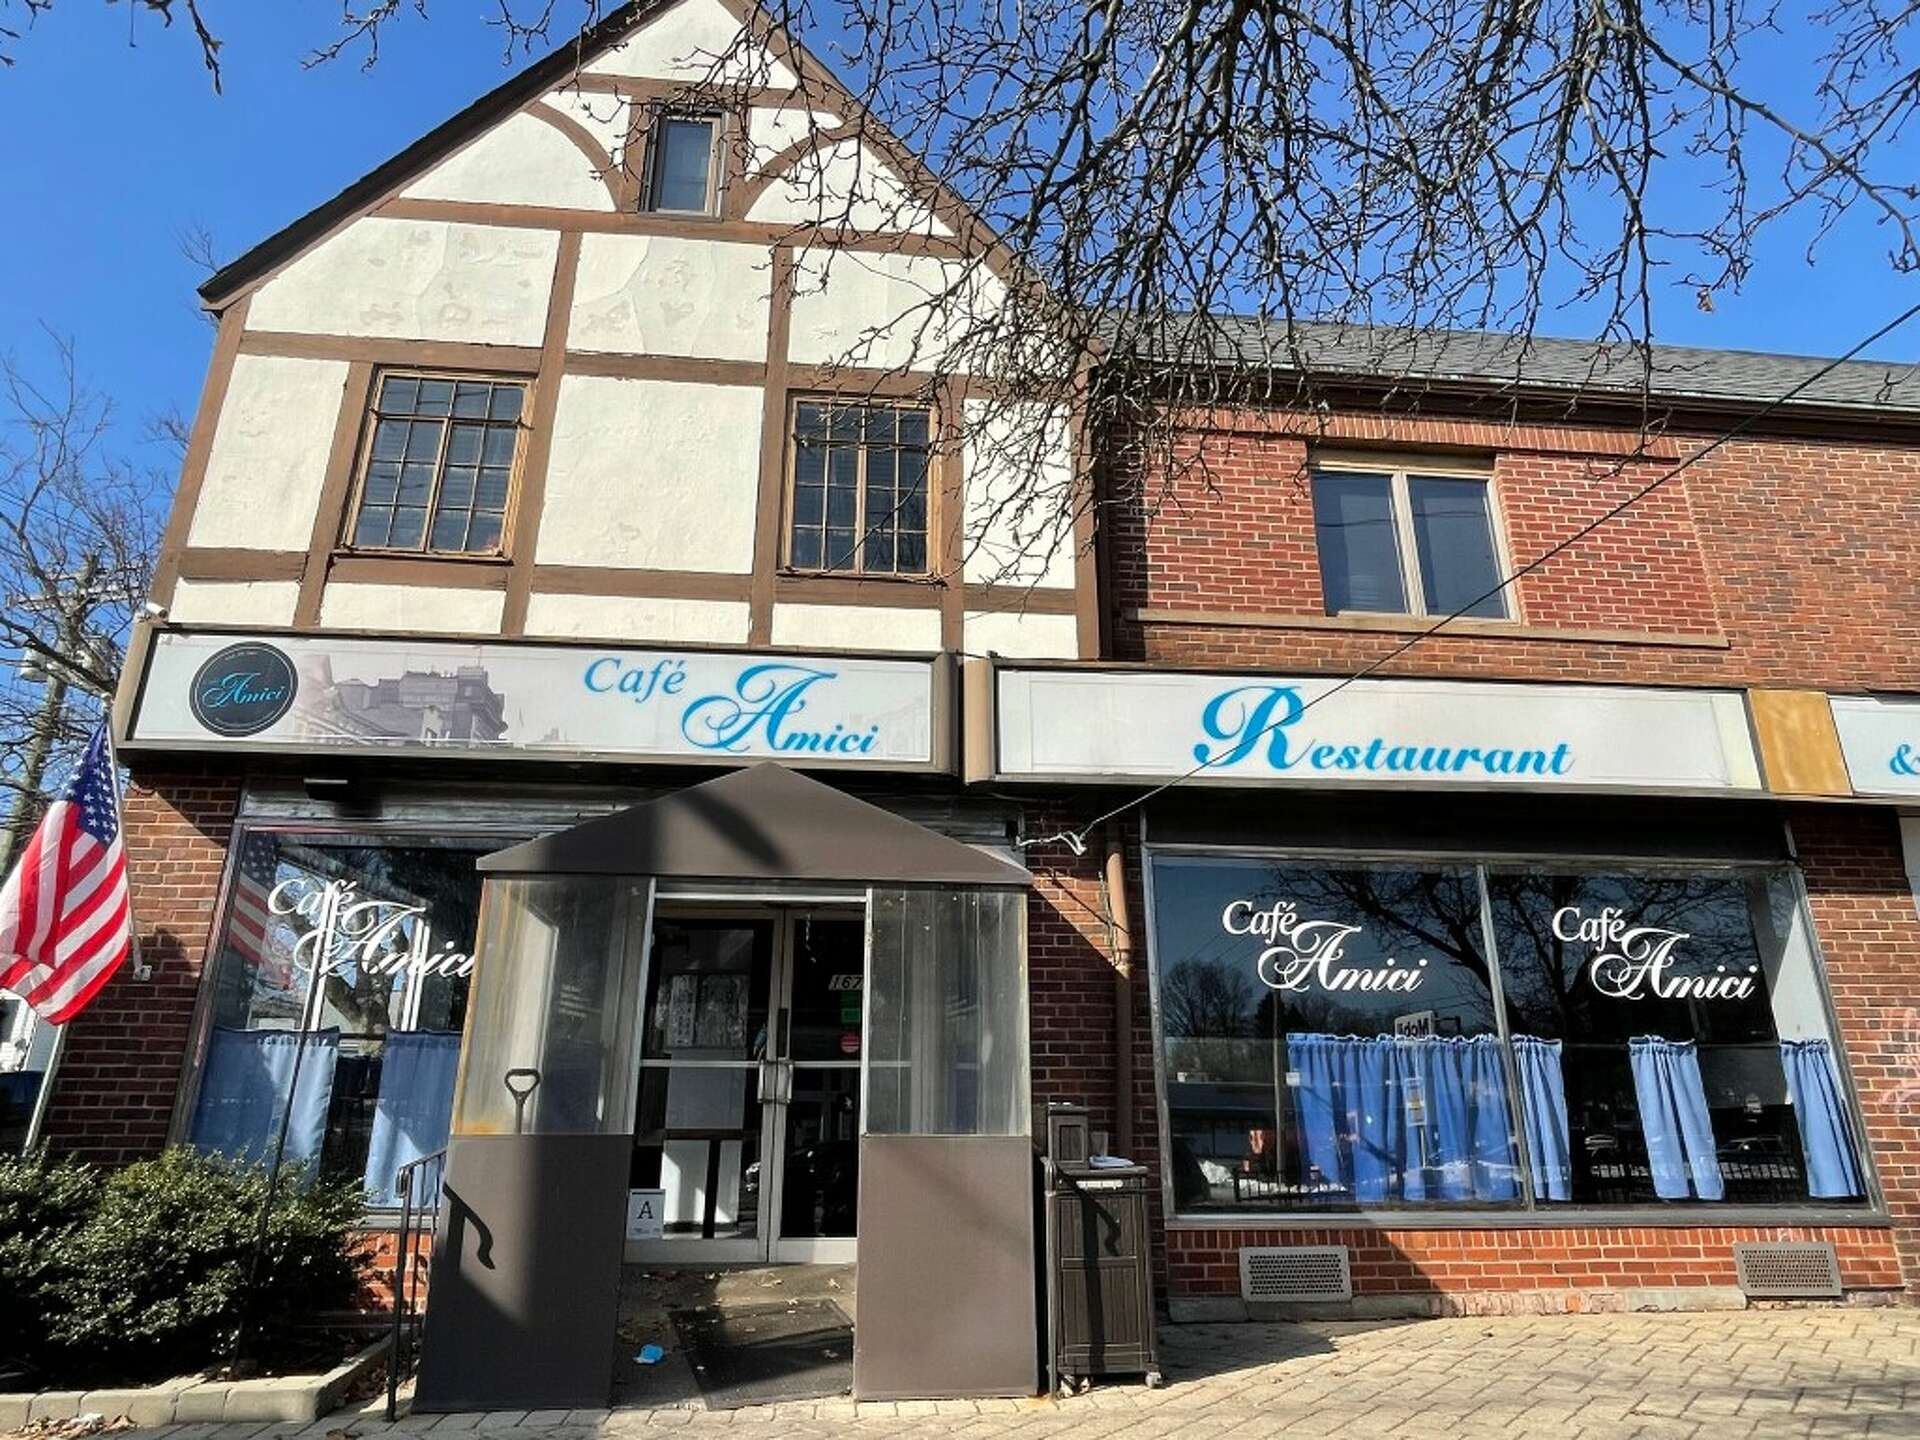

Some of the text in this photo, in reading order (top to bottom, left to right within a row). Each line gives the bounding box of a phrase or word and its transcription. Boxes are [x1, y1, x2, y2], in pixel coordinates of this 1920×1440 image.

[201, 671, 286, 708] Amici
[584, 657, 879, 753] Café Amici
[1193, 685, 1576, 775] Restaurant
[267, 878, 357, 927] Café
[1222, 900, 1428, 992] Café Amici
[1552, 906, 1758, 1000] Café Amici
[637, 1200, 654, 1219] A
